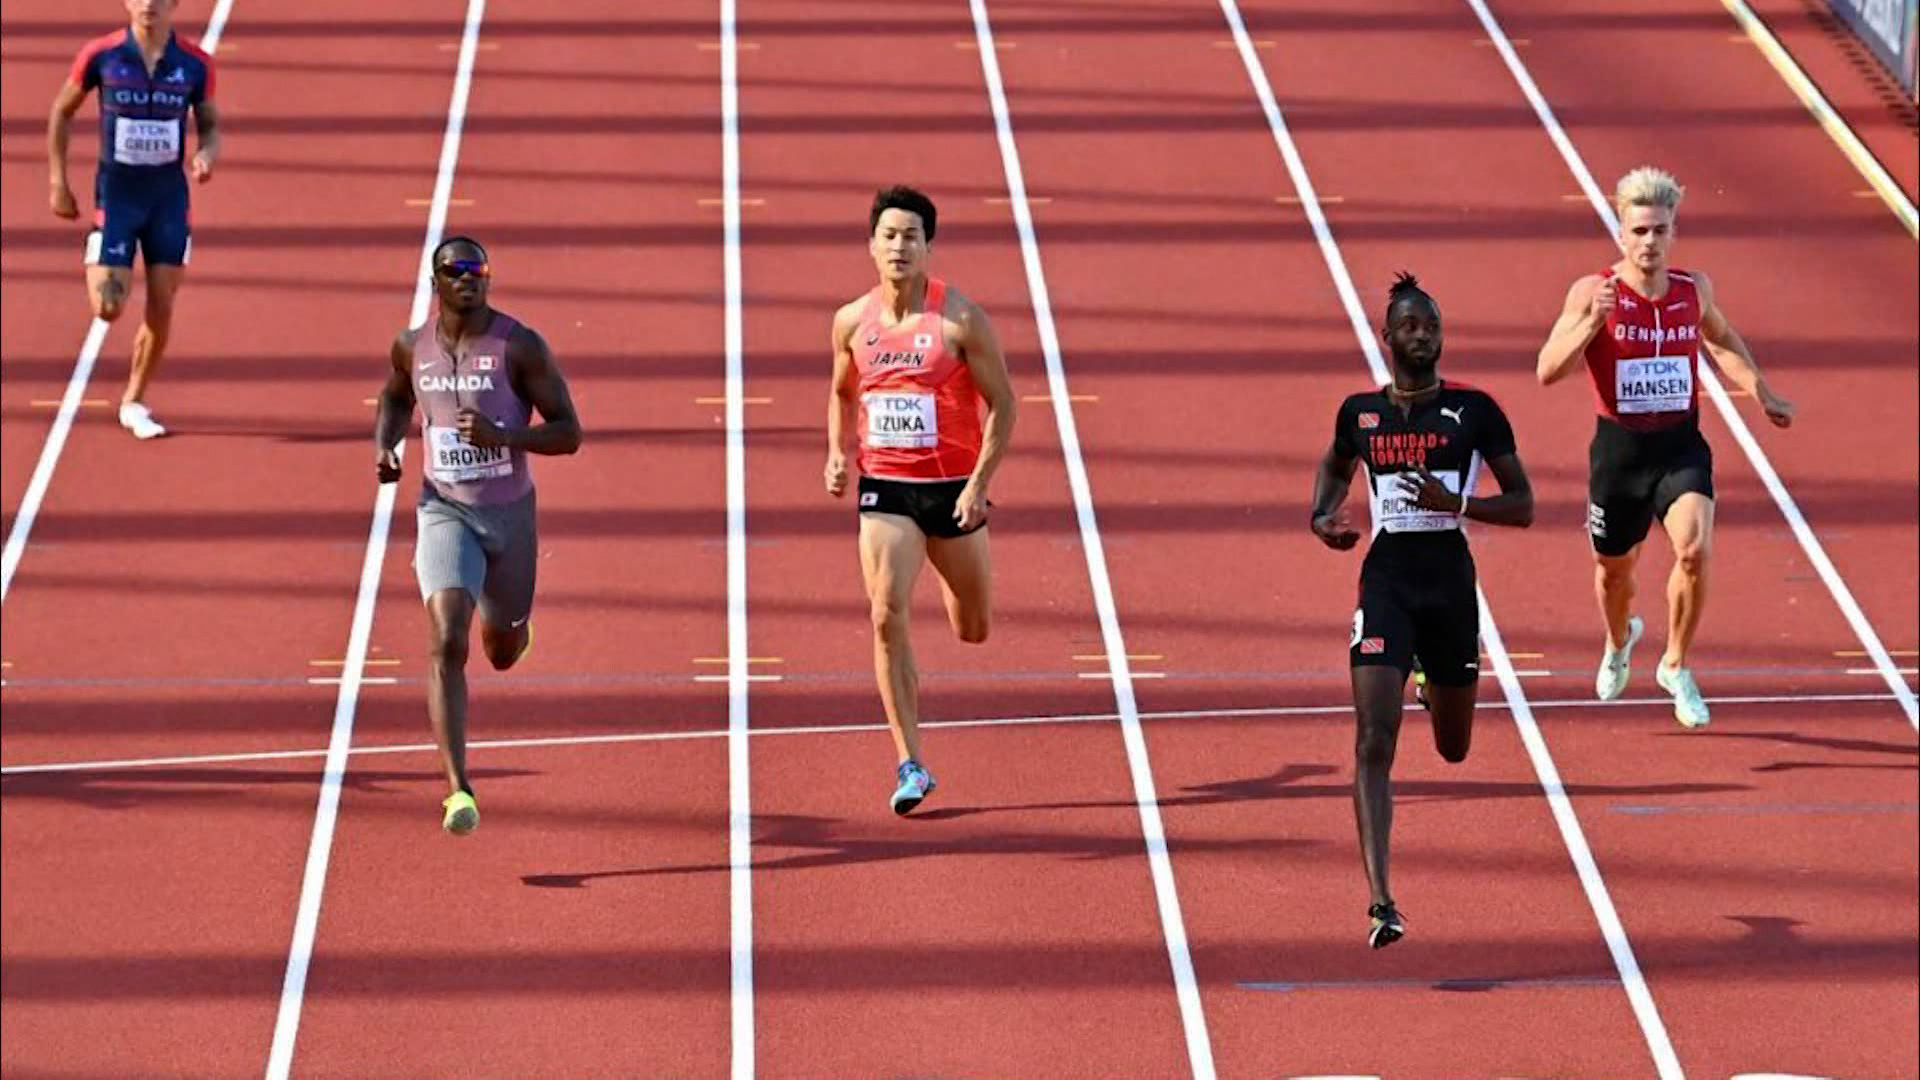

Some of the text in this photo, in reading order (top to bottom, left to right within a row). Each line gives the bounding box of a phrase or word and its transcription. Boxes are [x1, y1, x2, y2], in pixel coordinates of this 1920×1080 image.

[115, 89, 184, 105] GUAM
[139, 125, 169, 136] TDK
[125, 137, 171, 152] GREEN
[1614, 323, 1697, 342] DENMARK
[869, 352, 925, 366] JAPAN
[1640, 361, 1679, 374] TDK
[419, 375, 494, 392] CANADA
[1622, 379, 1688, 397] HANSEN
[883, 397, 922, 412] TDK
[1369, 433, 1437, 450] TRINIDAD
[440, 447, 502, 466] BROWN
[1370, 449, 1427, 467] TOBAGO
